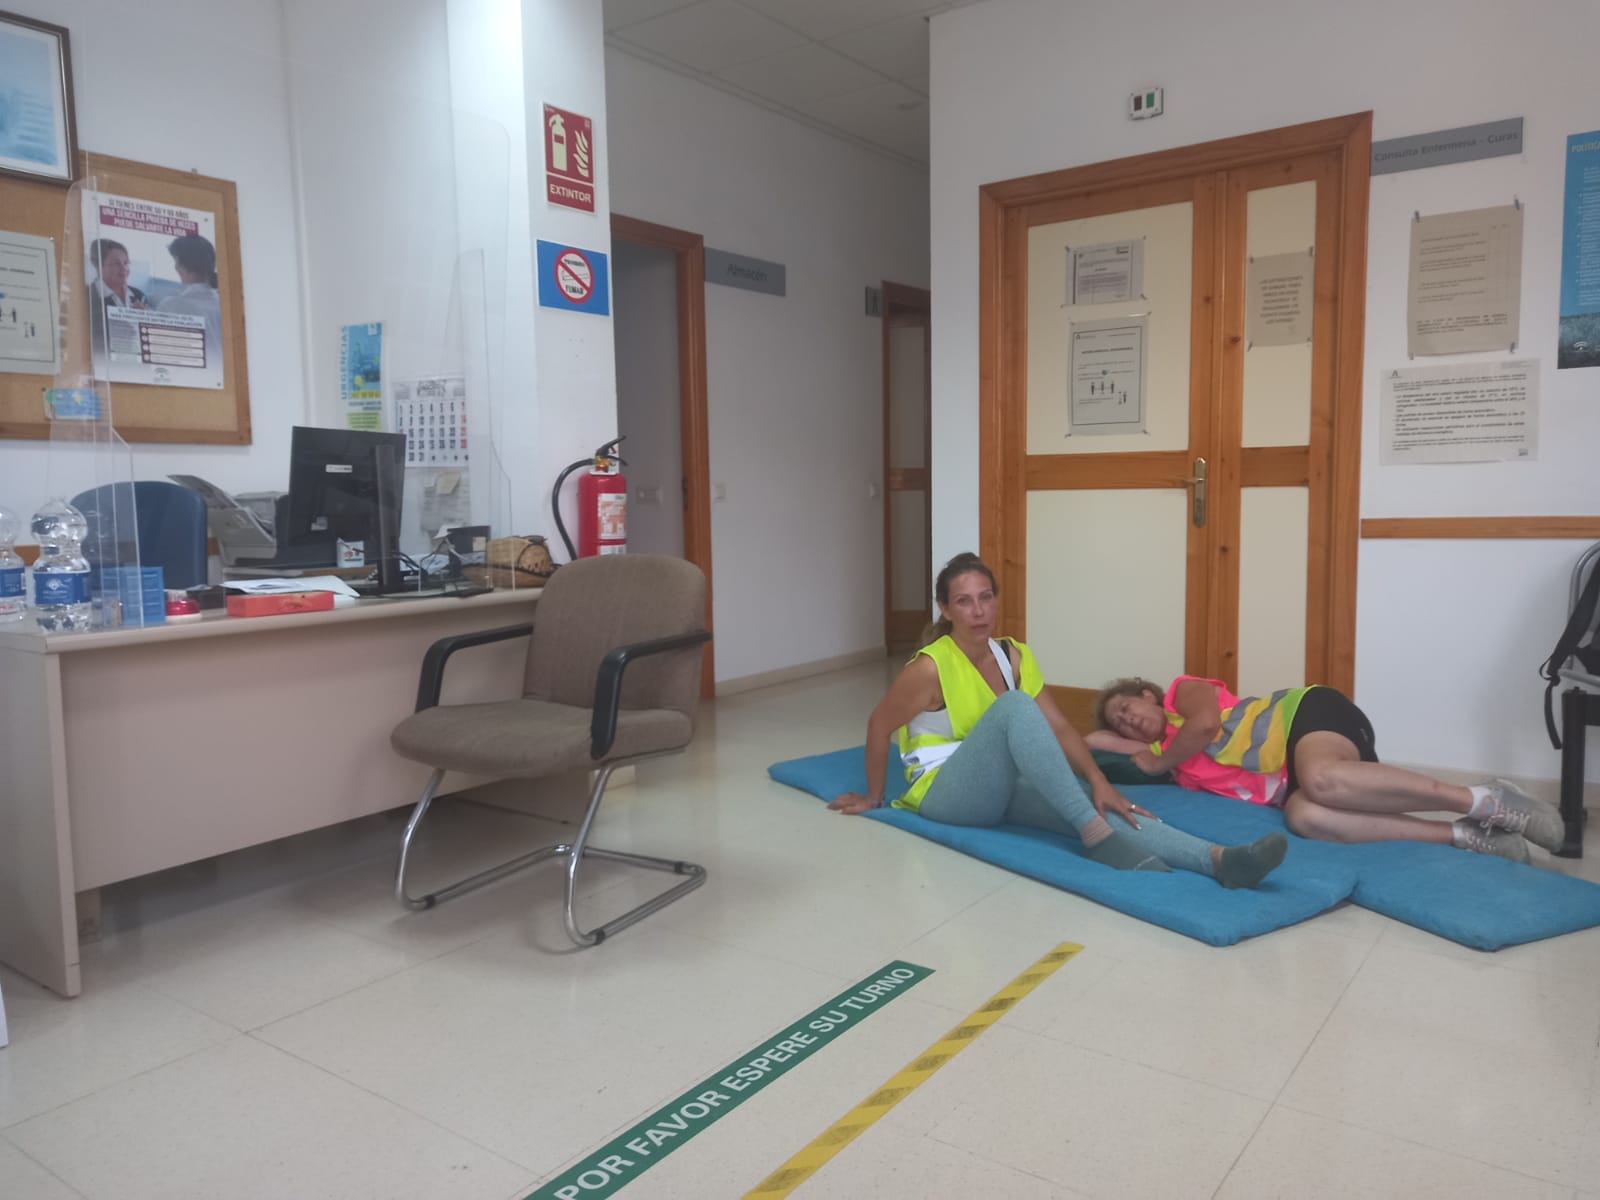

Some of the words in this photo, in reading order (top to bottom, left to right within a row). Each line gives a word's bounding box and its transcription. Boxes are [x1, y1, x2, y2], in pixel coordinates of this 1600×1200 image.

[1374, 147, 1419, 161] Consulta
[1487, 132, 1519, 145] Curas
[550, 184, 592, 203] EXTINTOR
[553, 1155, 635, 1200] POR
[624, 1090, 730, 1156] FAVOR
[720, 1031, 819, 1091] ESPERE
[809, 1010, 848, 1033] SU
[838, 968, 915, 1010] TURNO
